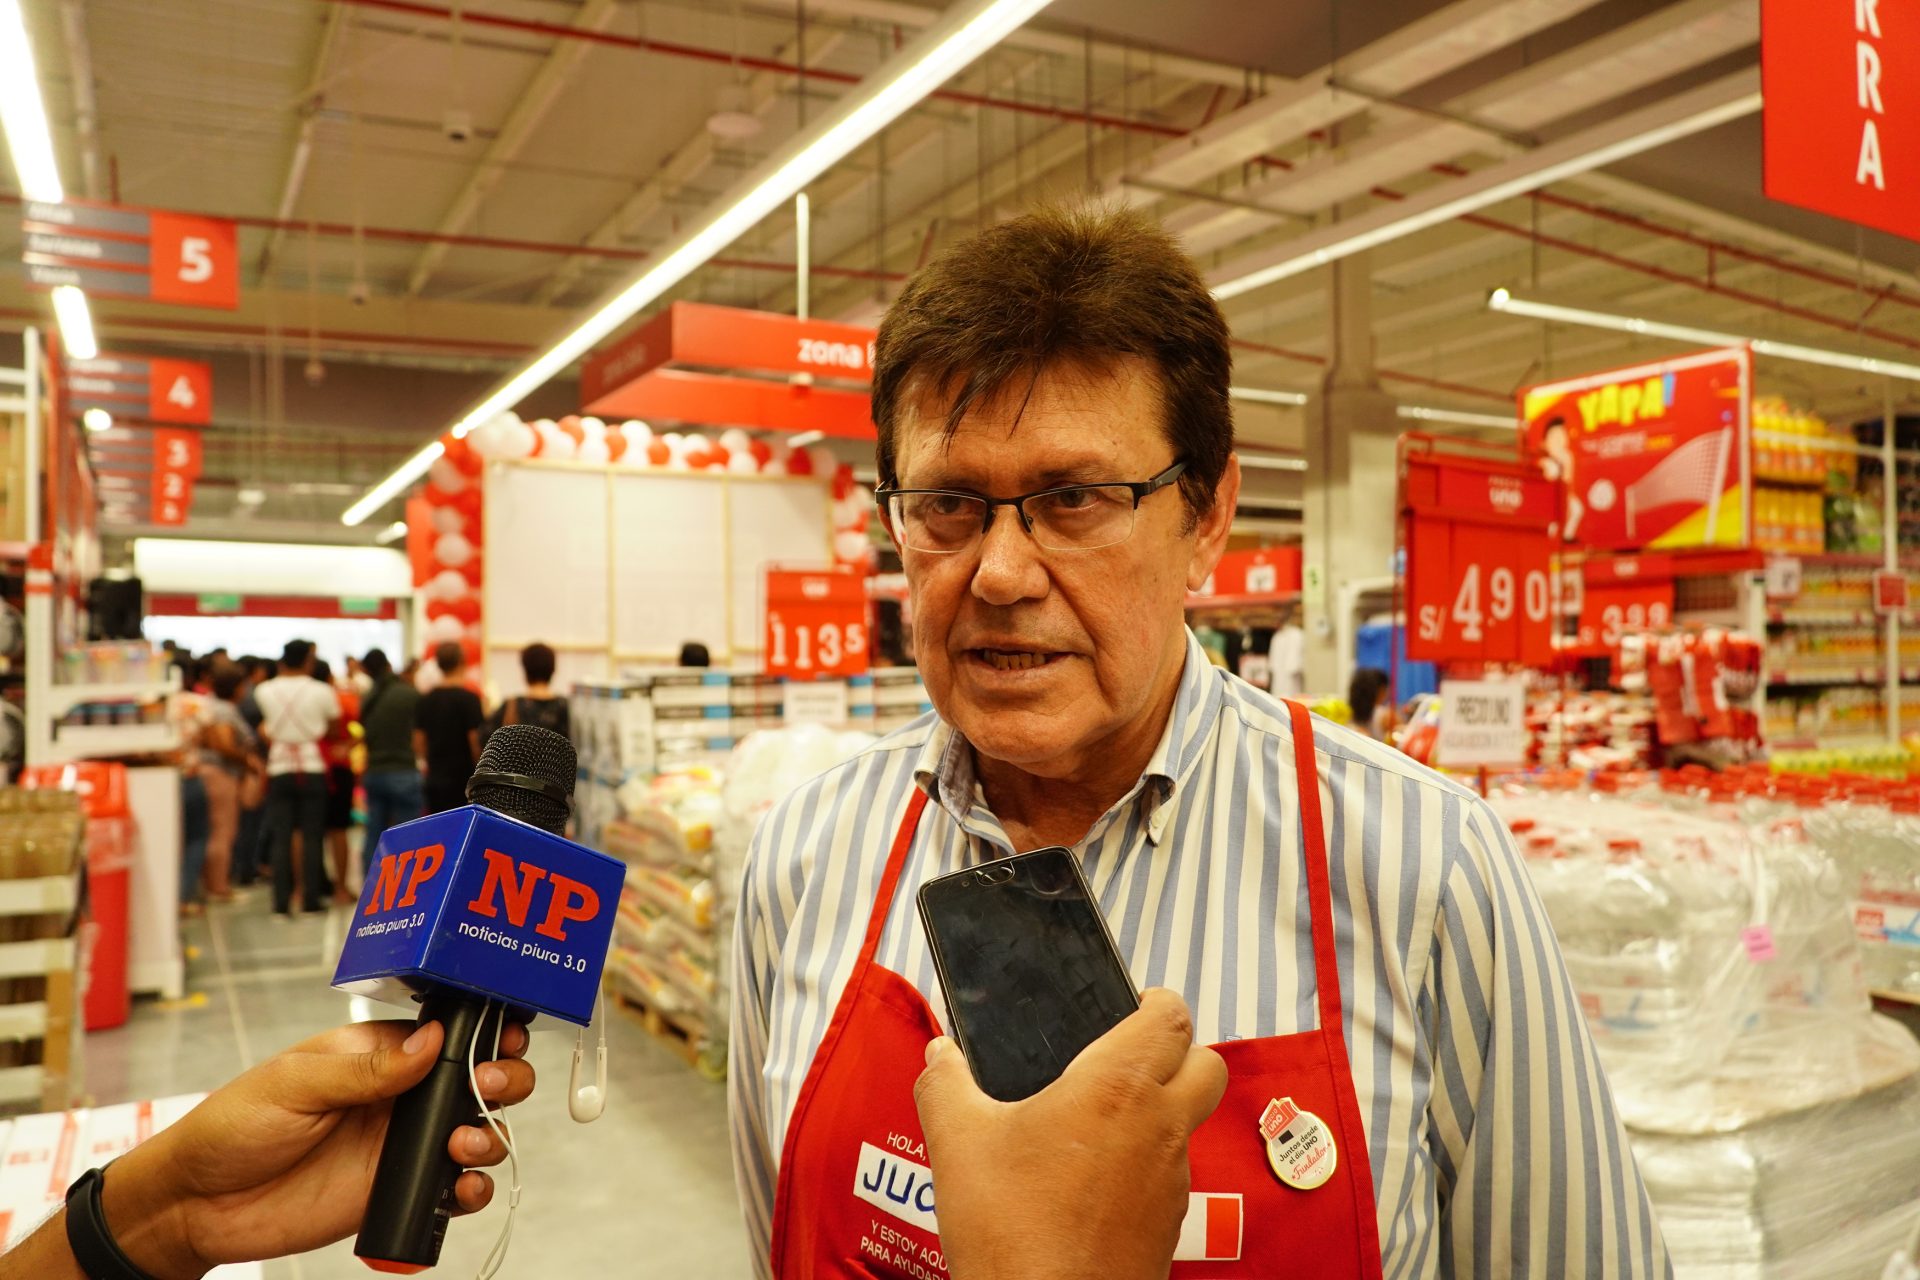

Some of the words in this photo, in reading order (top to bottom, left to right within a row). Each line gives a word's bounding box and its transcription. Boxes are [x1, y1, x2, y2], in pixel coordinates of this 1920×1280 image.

[177, 236, 214, 284] 5
[797, 338, 864, 369] zona
[167, 375, 197, 409] 4
[166, 438, 190, 468] 3
[364, 844, 446, 917] NP
[468, 848, 600, 942] NP
[356, 921, 386, 938] noticias
[385, 915, 410, 936] piura
[409, 912, 425, 929] 3.0
[458, 921, 519, 951] noticias
[521, 942, 560, 965] piura
[563, 955, 587, 973] 3.0
[886, 1131, 926, 1161] HOLA,
[1279, 1141, 1301, 1162] Juntos
[1300, 1124, 1319, 1144] desde
[1289, 1157, 1296, 1165] el
[1303, 1135, 1318, 1151] UNO
[1293, 1146, 1327, 1180] Fundador
[860, 1235, 891, 1264] PARA
[871, 1219, 879, 1235] Y
[880, 1225, 918, 1255] ESTOY
[919, 1247, 950, 1273] AQU
